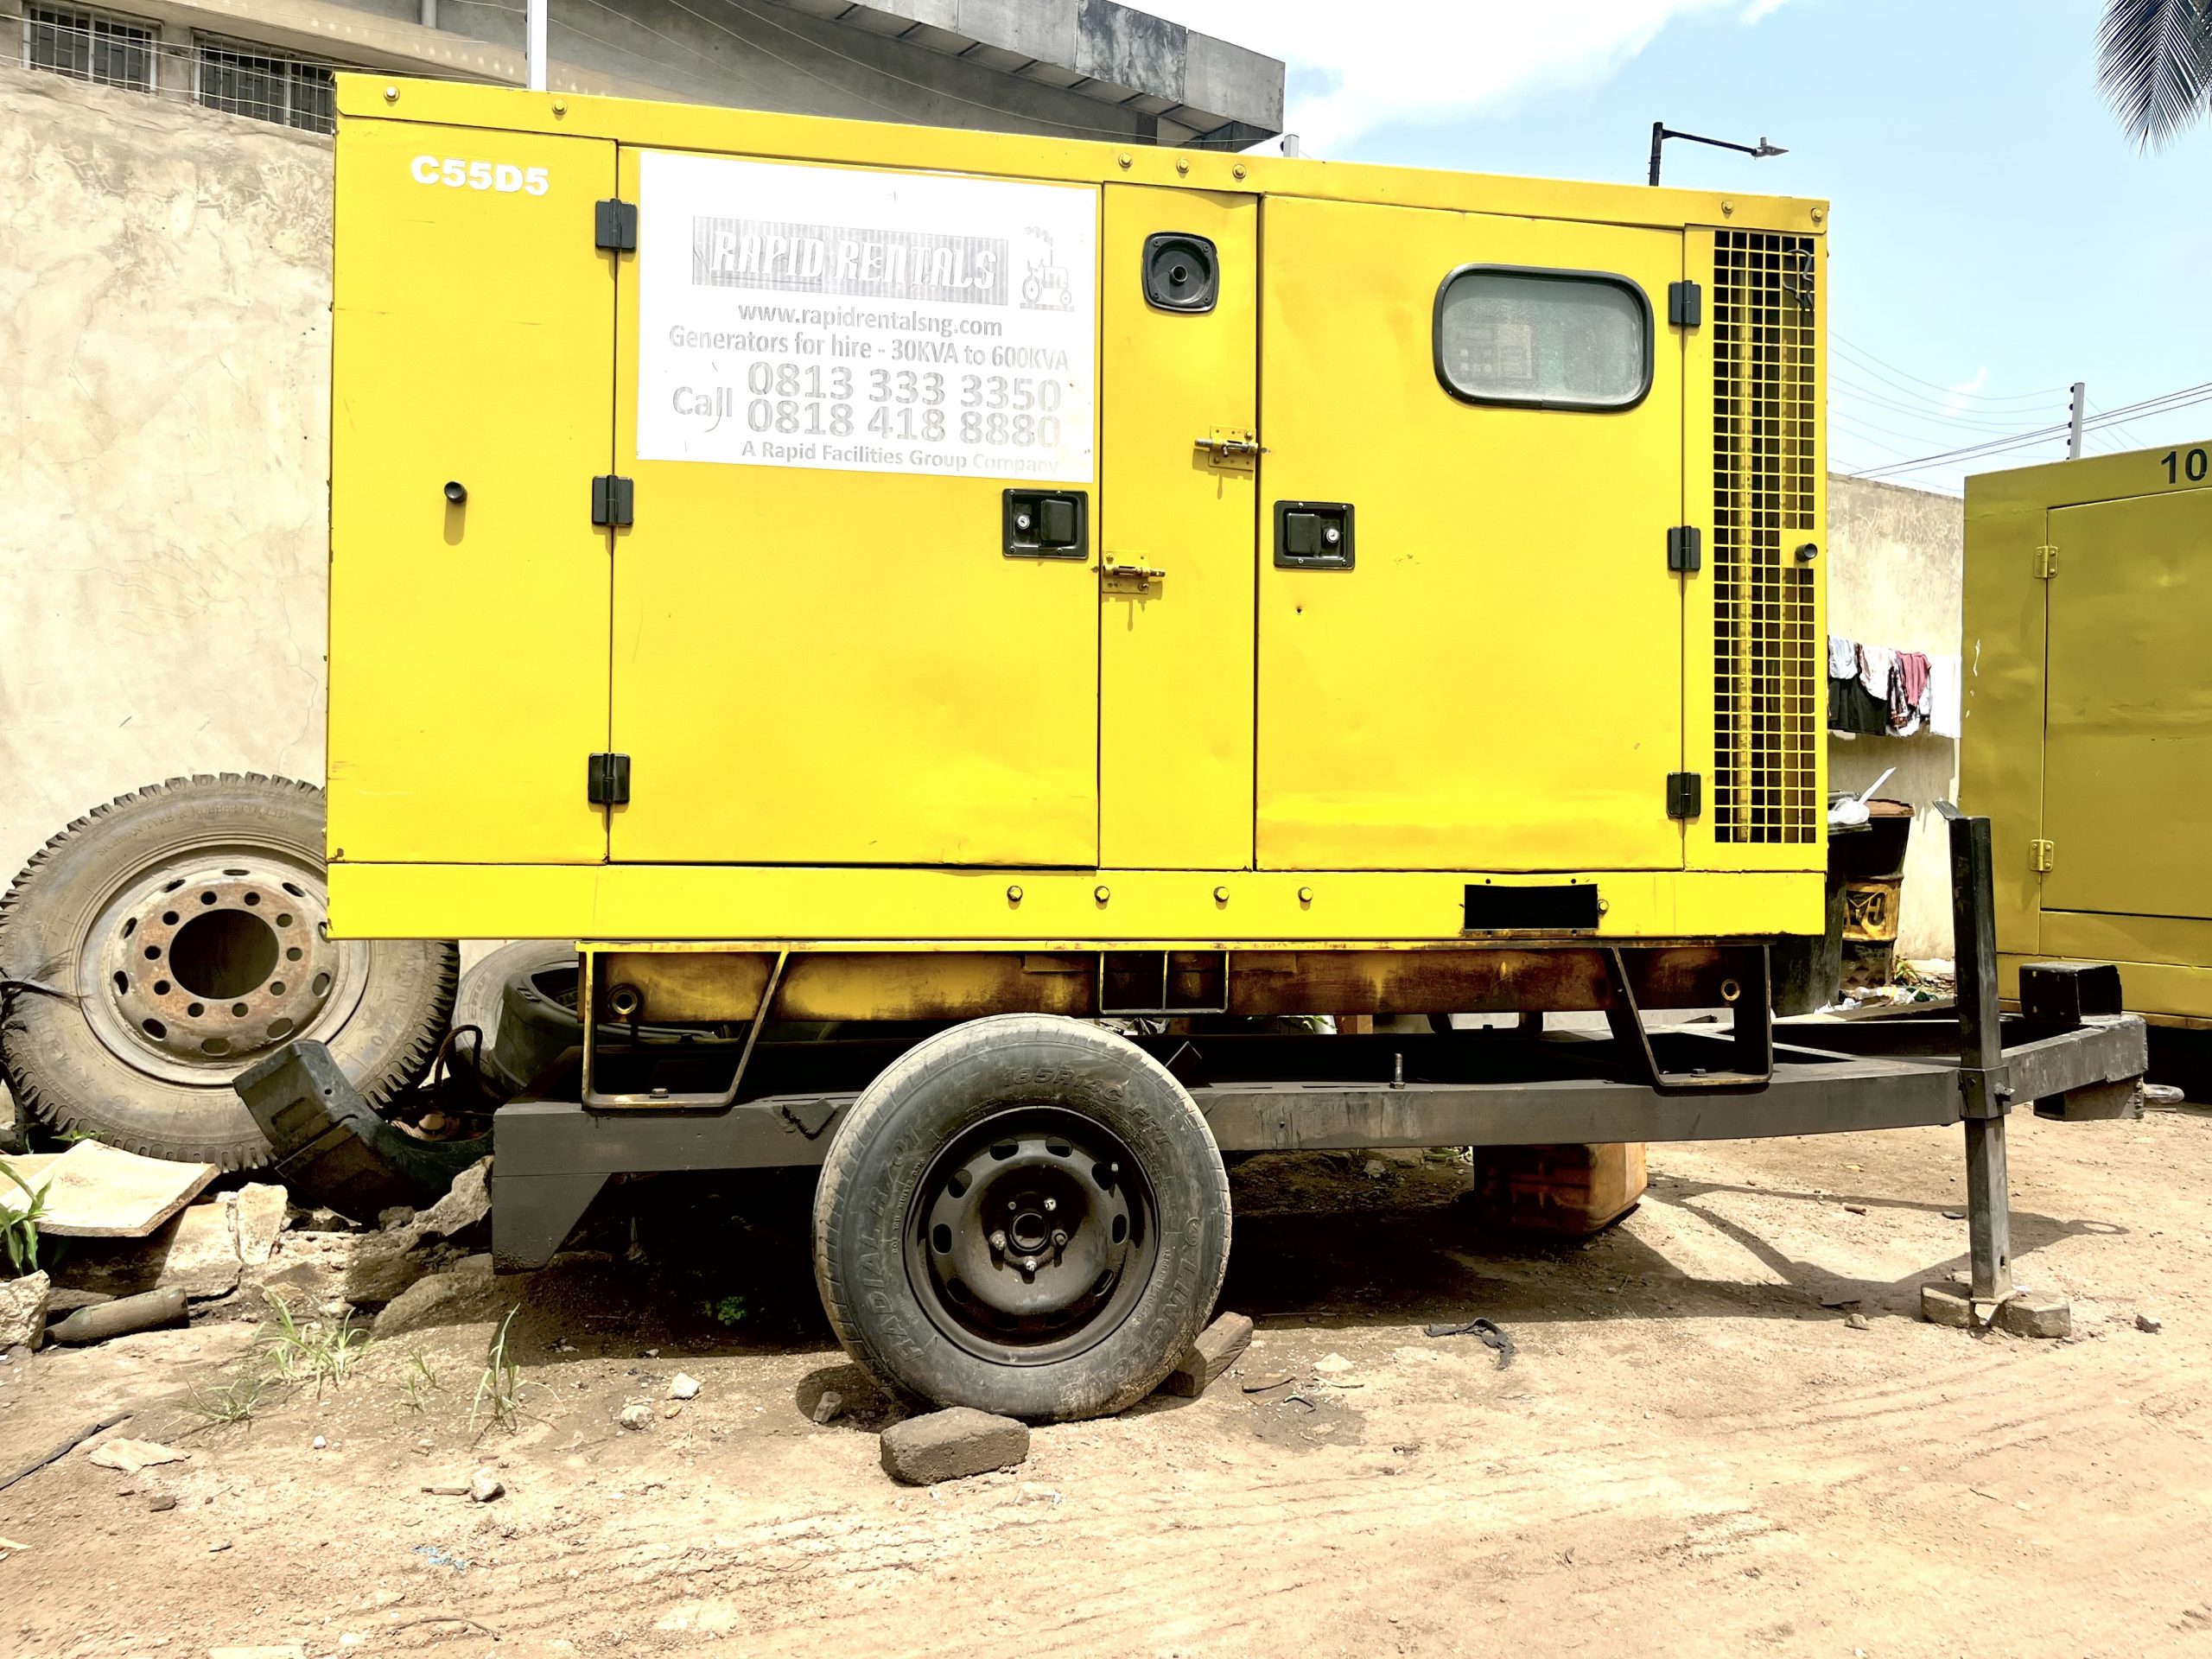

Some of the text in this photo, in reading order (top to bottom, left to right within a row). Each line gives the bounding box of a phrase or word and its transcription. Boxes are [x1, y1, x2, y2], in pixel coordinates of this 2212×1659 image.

[411, 155, 550, 196] C55D5
[710, 230, 998, 289] RAPID RENTALS
[737, 303, 1003, 338] www.rapidrentalsng.com
[669, 325, 789, 353] Generators
[794, 330, 825, 354] for
[830, 334, 873, 359] hire
[892, 339, 959, 365] 30KVA
[964, 345, 986, 367] to
[991, 345, 1071, 371] 600KVA
[671, 385, 733, 418] Call
[747, 360, 1062, 412] 0813 333 3350
[747, 397, 1062, 448] 0818 418 8880
[741, 441, 1059, 475] A Rapid Facilities Group Company
[2161, 448, 2208, 484] 10
[1002, 1065, 1125, 1103] 185R14C
